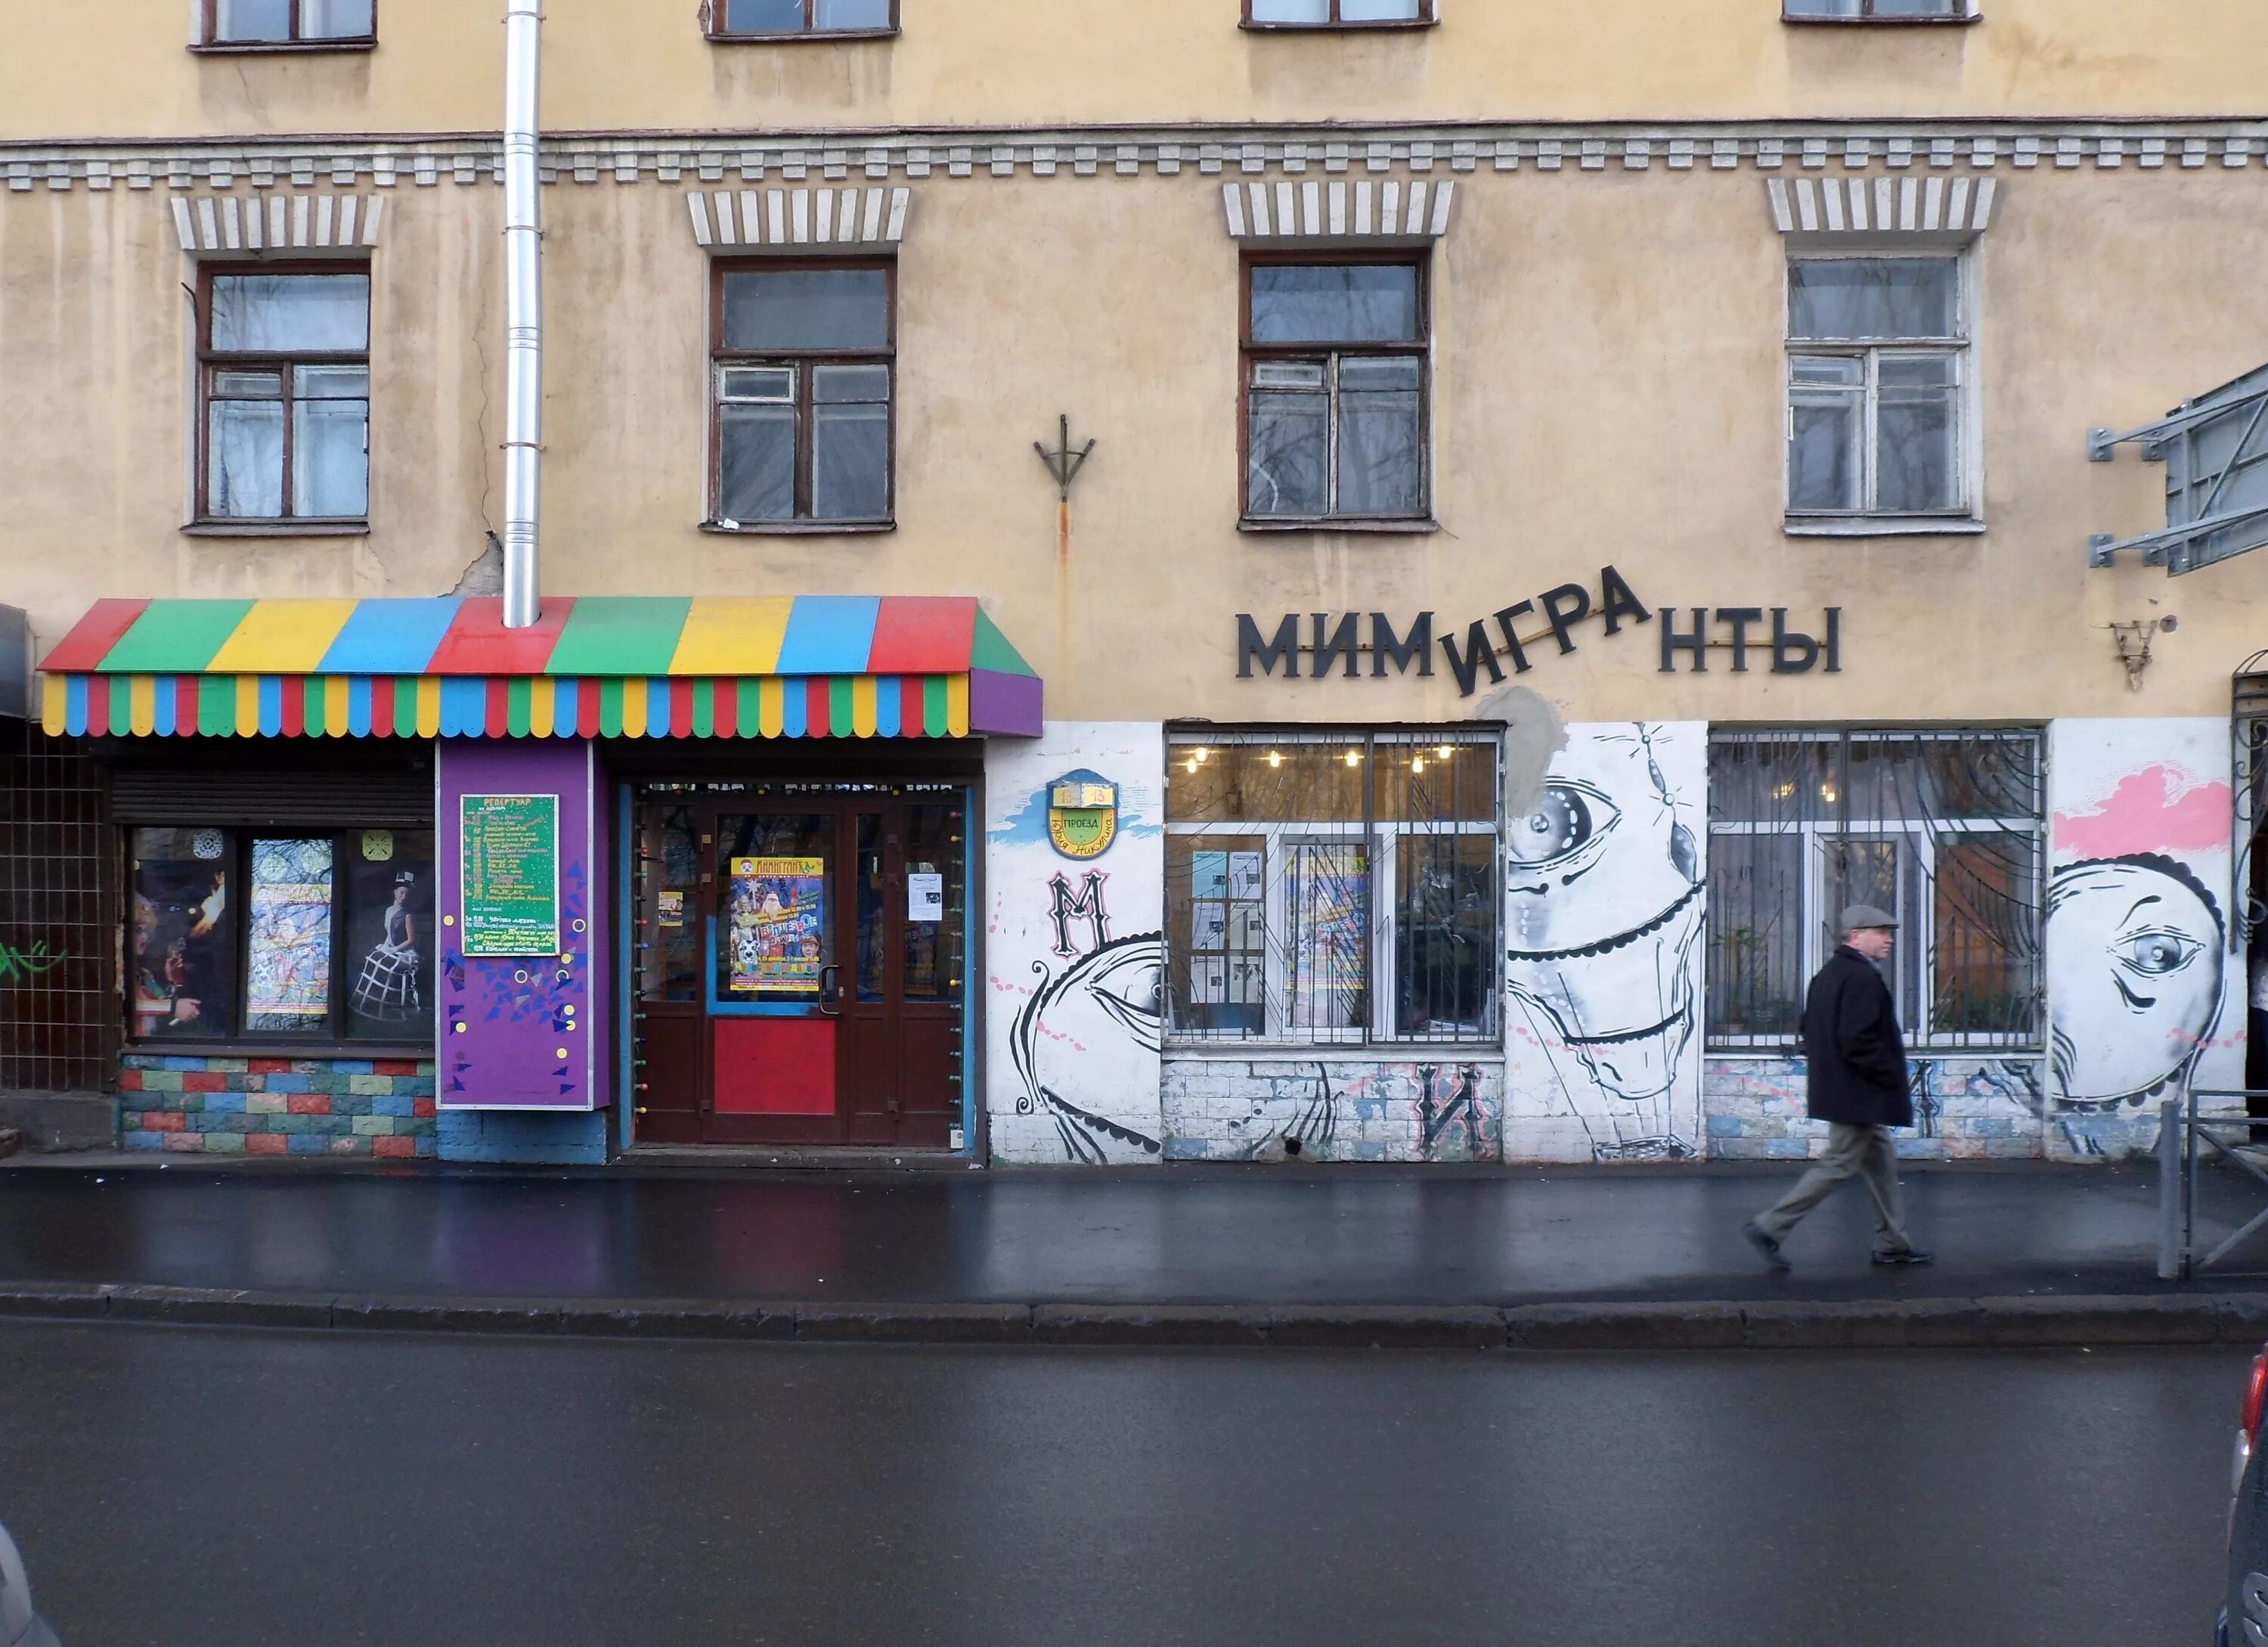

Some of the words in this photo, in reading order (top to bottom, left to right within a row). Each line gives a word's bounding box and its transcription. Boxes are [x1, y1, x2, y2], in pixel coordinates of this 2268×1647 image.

[1235, 563, 1842, 699] МИМИГРАНТЫ
[484, 798, 531, 806] РЕПЕРТУАР
[1063, 819, 1098, 829] ПРОЕЗД
